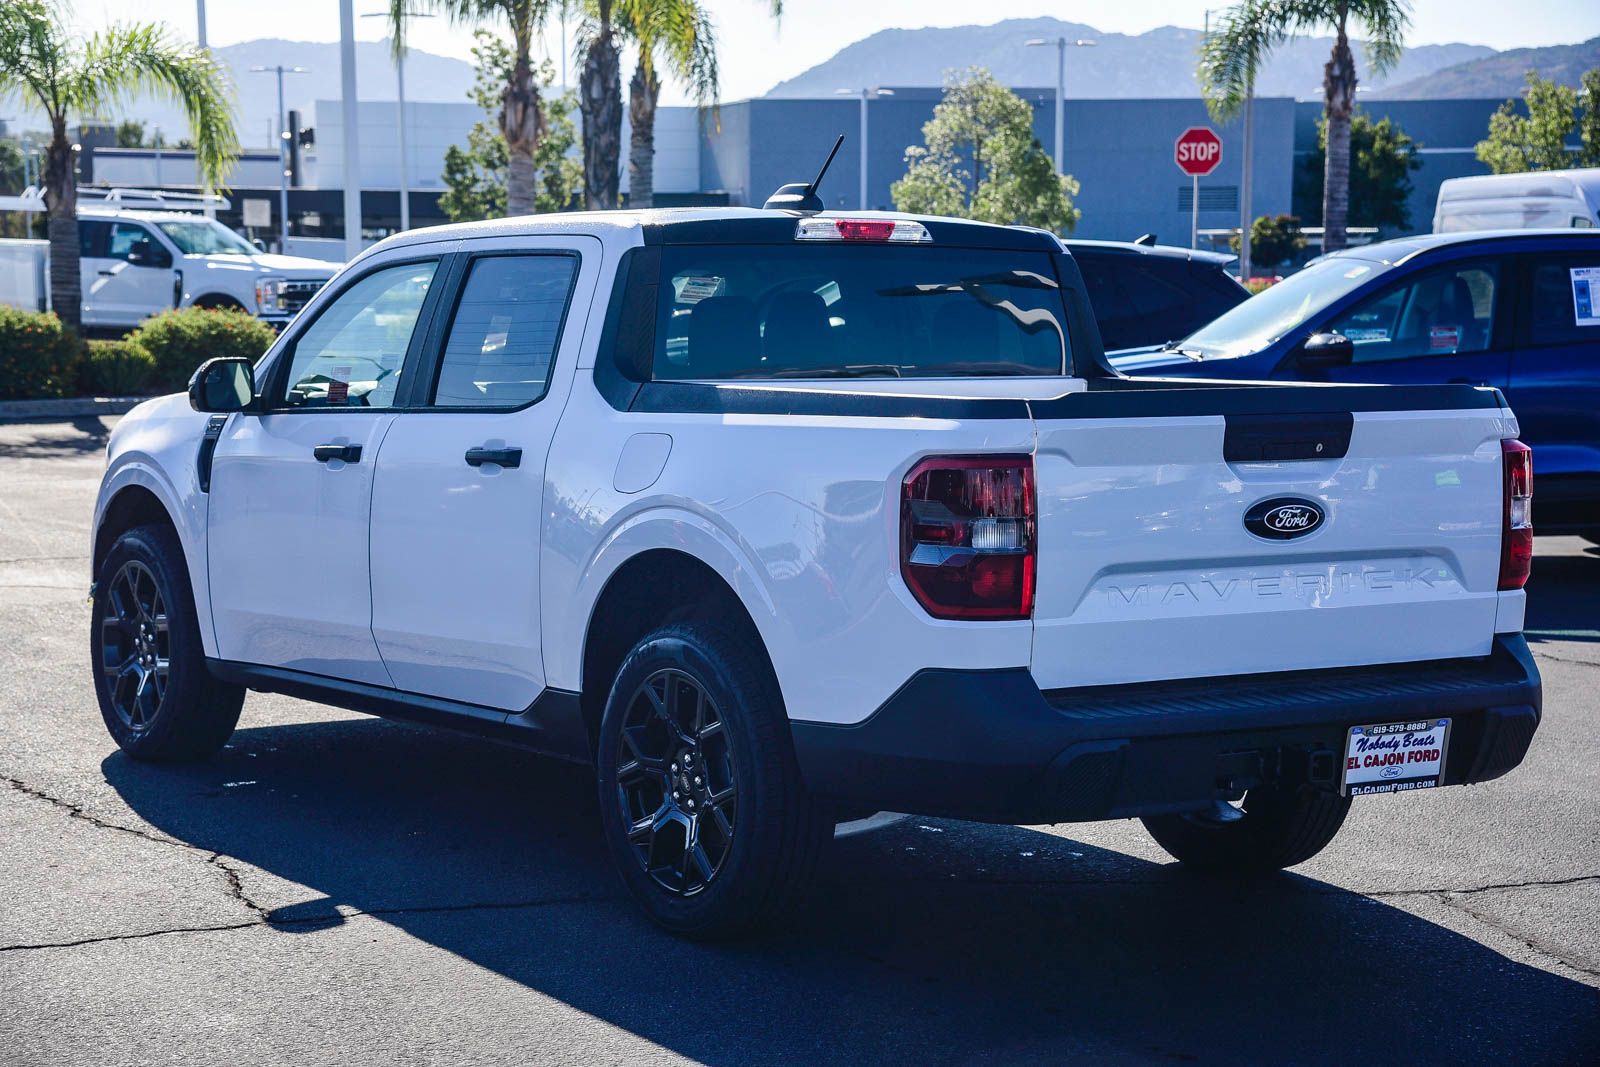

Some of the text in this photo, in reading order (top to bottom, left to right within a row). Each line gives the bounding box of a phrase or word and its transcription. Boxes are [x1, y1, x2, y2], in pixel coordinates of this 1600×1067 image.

[1179, 142, 1219, 161] STOP
[1275, 508, 1310, 528] Ford
[1107, 567, 1435, 607] MAVERICK
[1373, 722, 1427, 734] 619-579-8888
[1356, 732, 1435, 752] Nobody Beats
[1347, 749, 1440, 770] EL CAJON FORD
[1383, 766, 1400, 777] Ford
